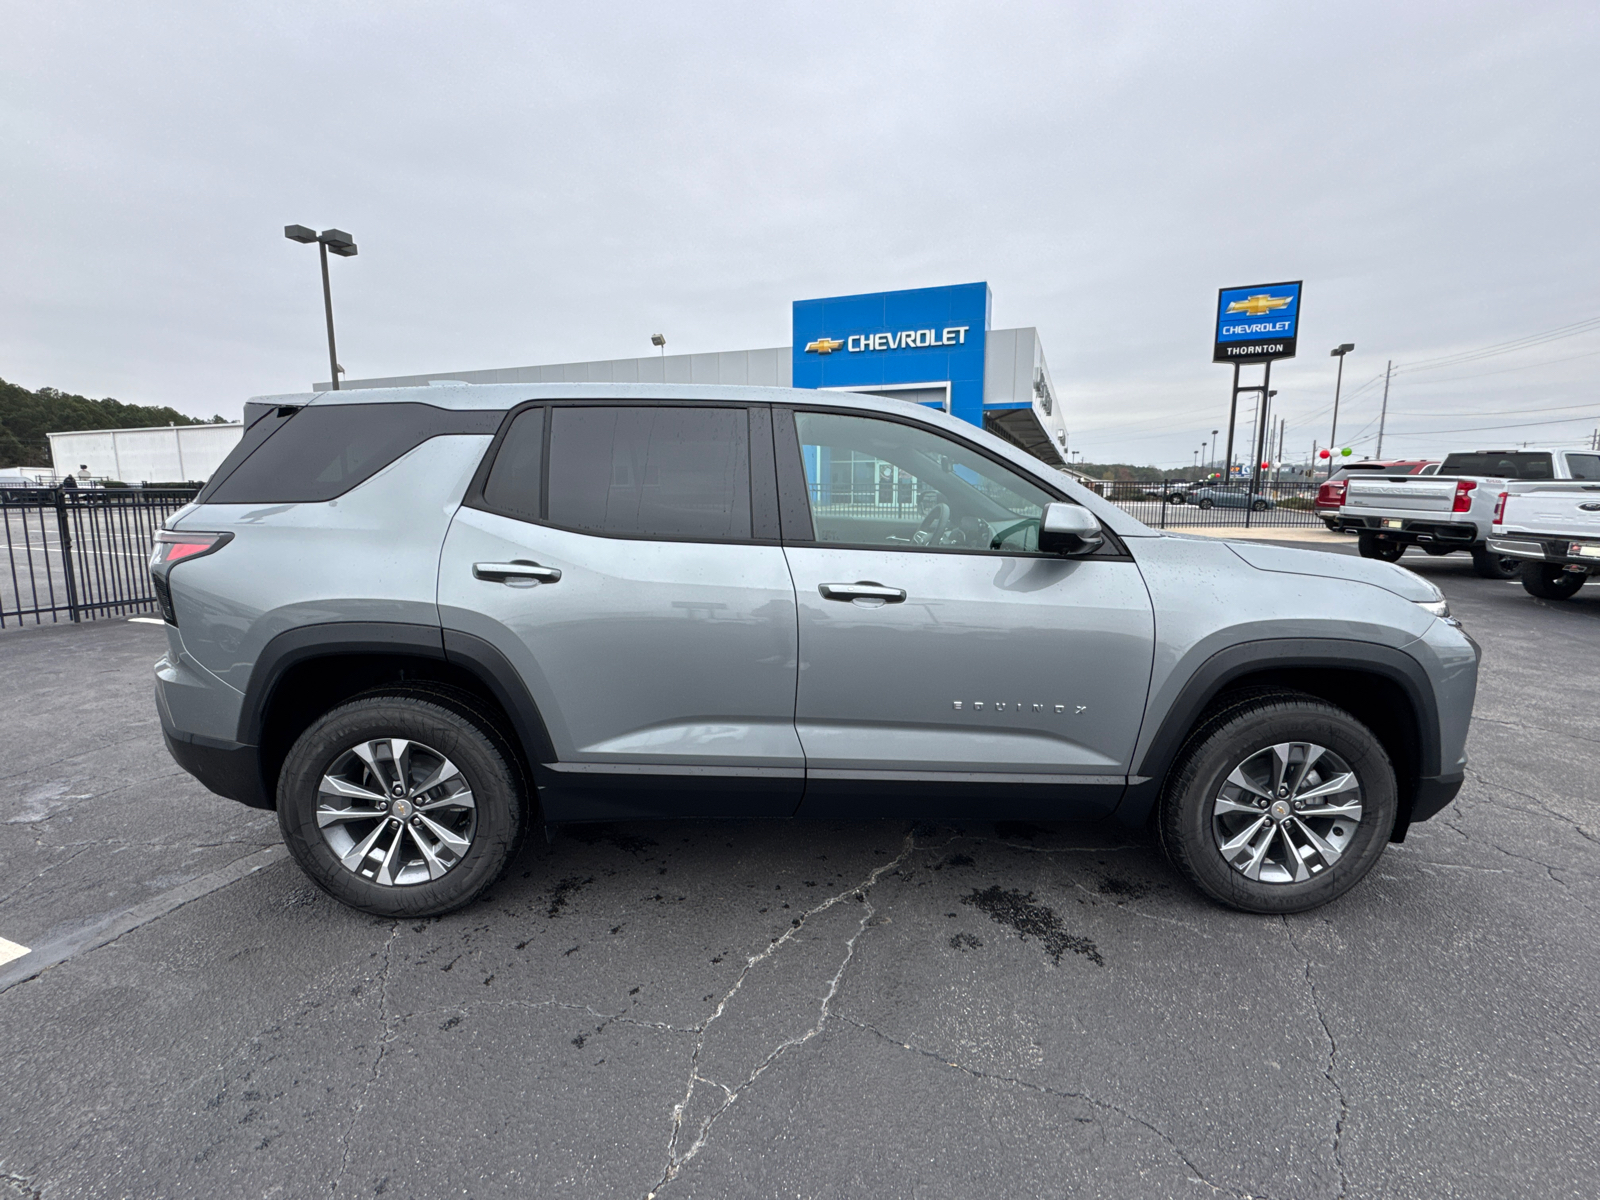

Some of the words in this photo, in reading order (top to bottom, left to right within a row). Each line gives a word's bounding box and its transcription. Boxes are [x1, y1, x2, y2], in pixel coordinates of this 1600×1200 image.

[1222, 321, 1291, 335] CHEVROLET
[847, 326, 969, 353] CHEVROLET
[1226, 344, 1284, 355] THORNTON
[953, 701, 1087, 715] EQUINOX
